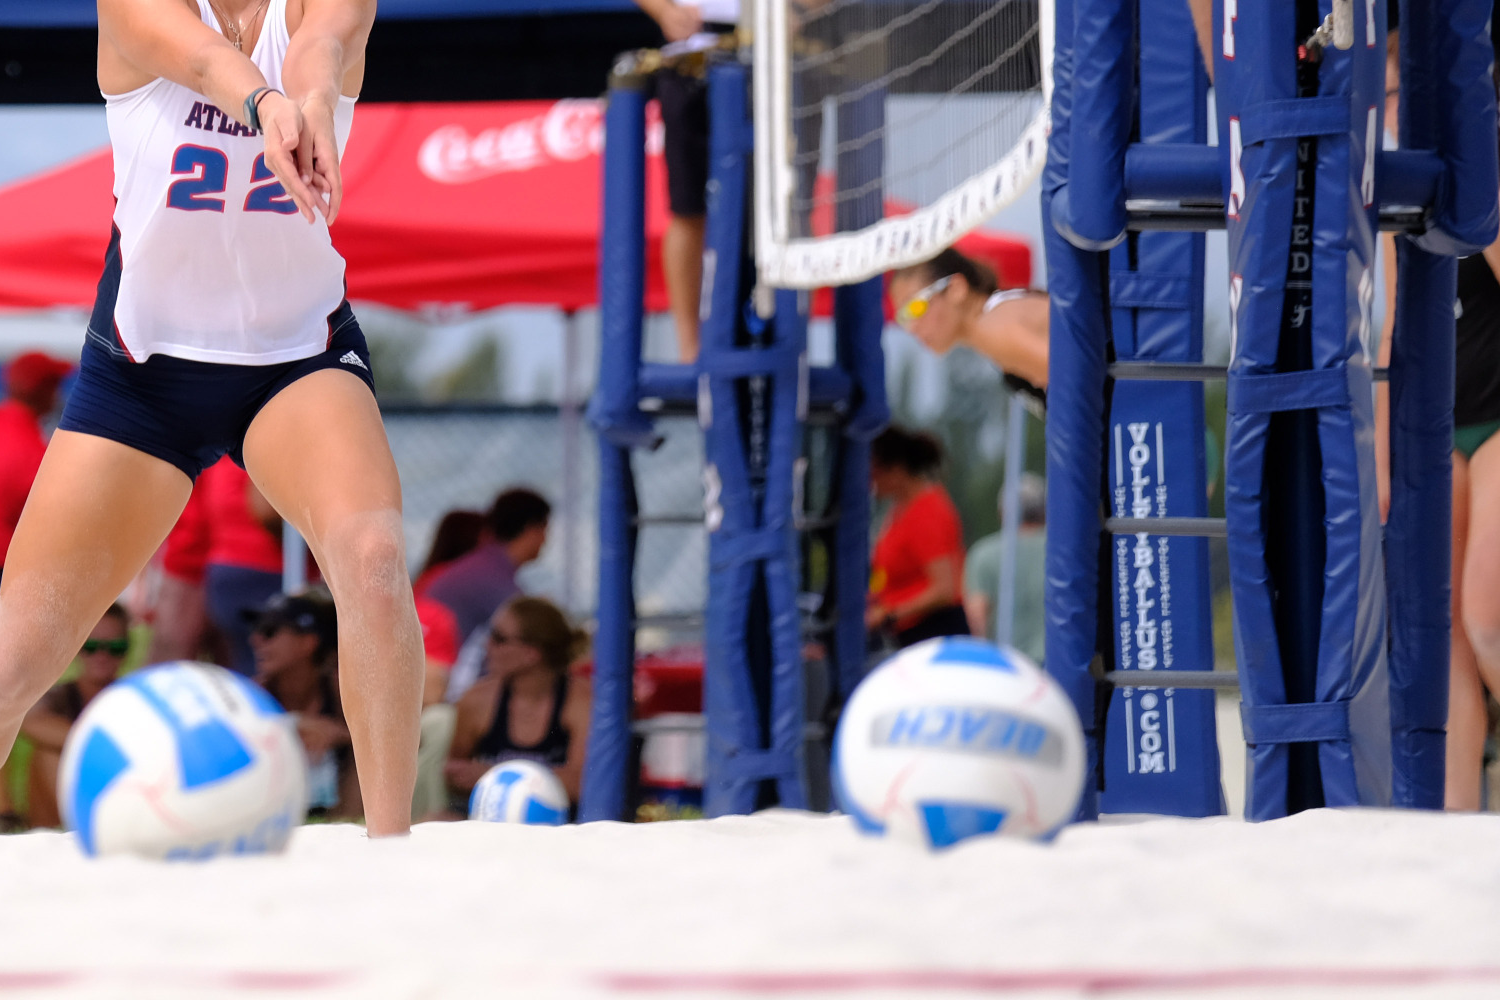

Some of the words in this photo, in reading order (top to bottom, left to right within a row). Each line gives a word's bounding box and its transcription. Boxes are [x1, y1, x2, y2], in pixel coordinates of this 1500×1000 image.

[166, 143, 300, 215] 22
[1291, 140, 1309, 273] NITED
[1127, 422, 1165, 774] VOLLYBALLUS.COM
